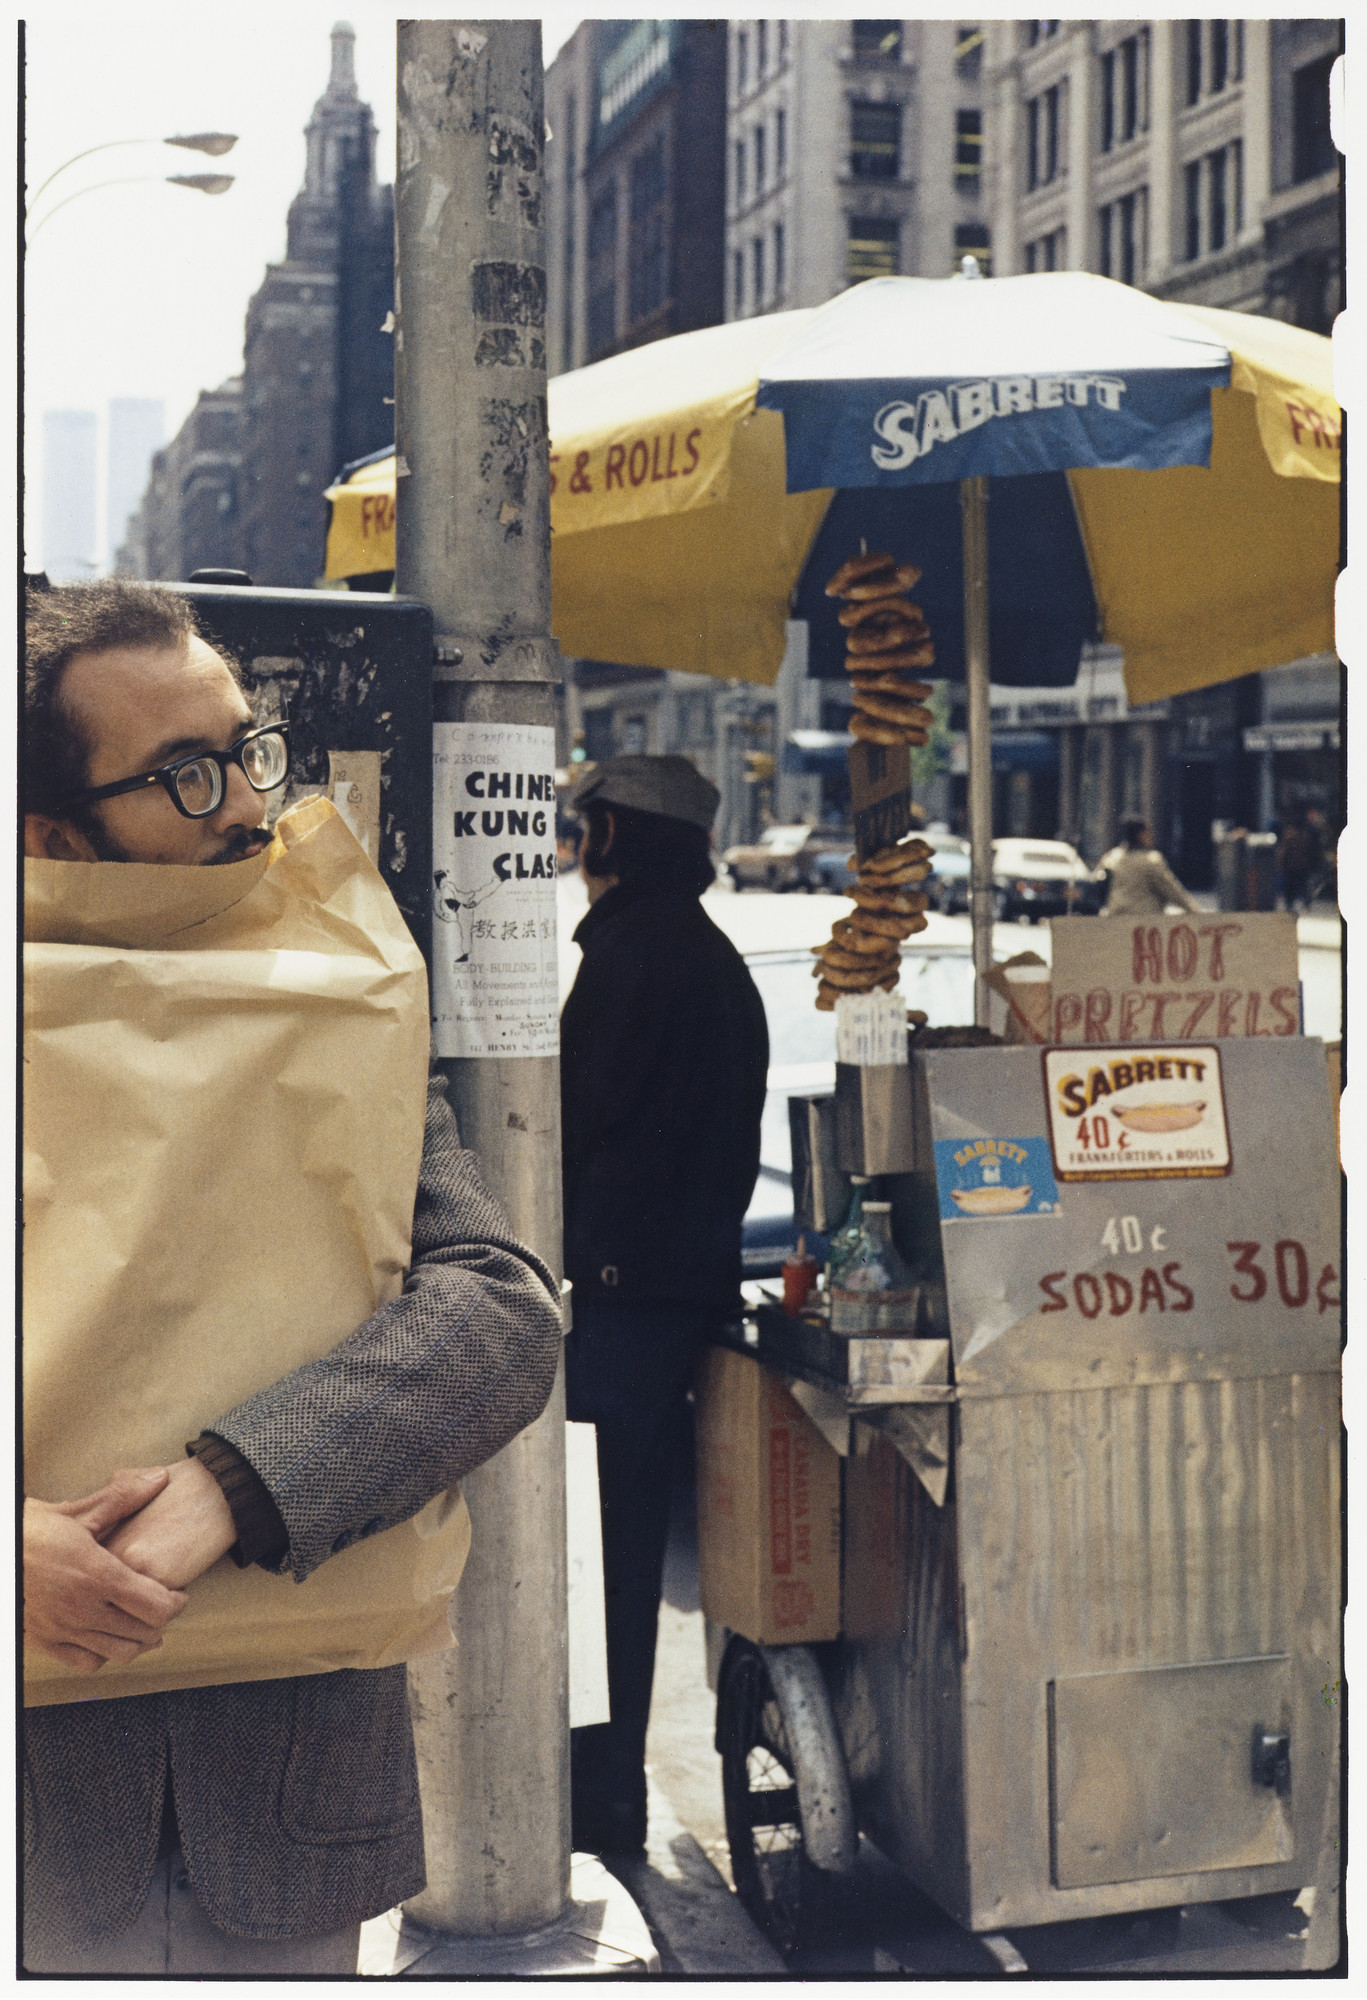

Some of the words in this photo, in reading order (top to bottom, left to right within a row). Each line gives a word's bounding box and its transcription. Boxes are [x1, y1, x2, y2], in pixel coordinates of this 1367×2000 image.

[871, 374, 1126, 470] SABRETT
[569, 450, 593, 494] &
[606, 427, 702, 490] ROLLS
[465, 771, 555, 802] CHINE
[454, 810, 547, 837] KUNG
[493, 853, 557, 882] CLAS
[1132, 923, 1243, 984] HOT
[1053, 986, 1298, 1043] PRETZELS
[1057, 1054, 1208, 1118] SABRETT
[1038, 1261, 1195, 1319] SODAS
